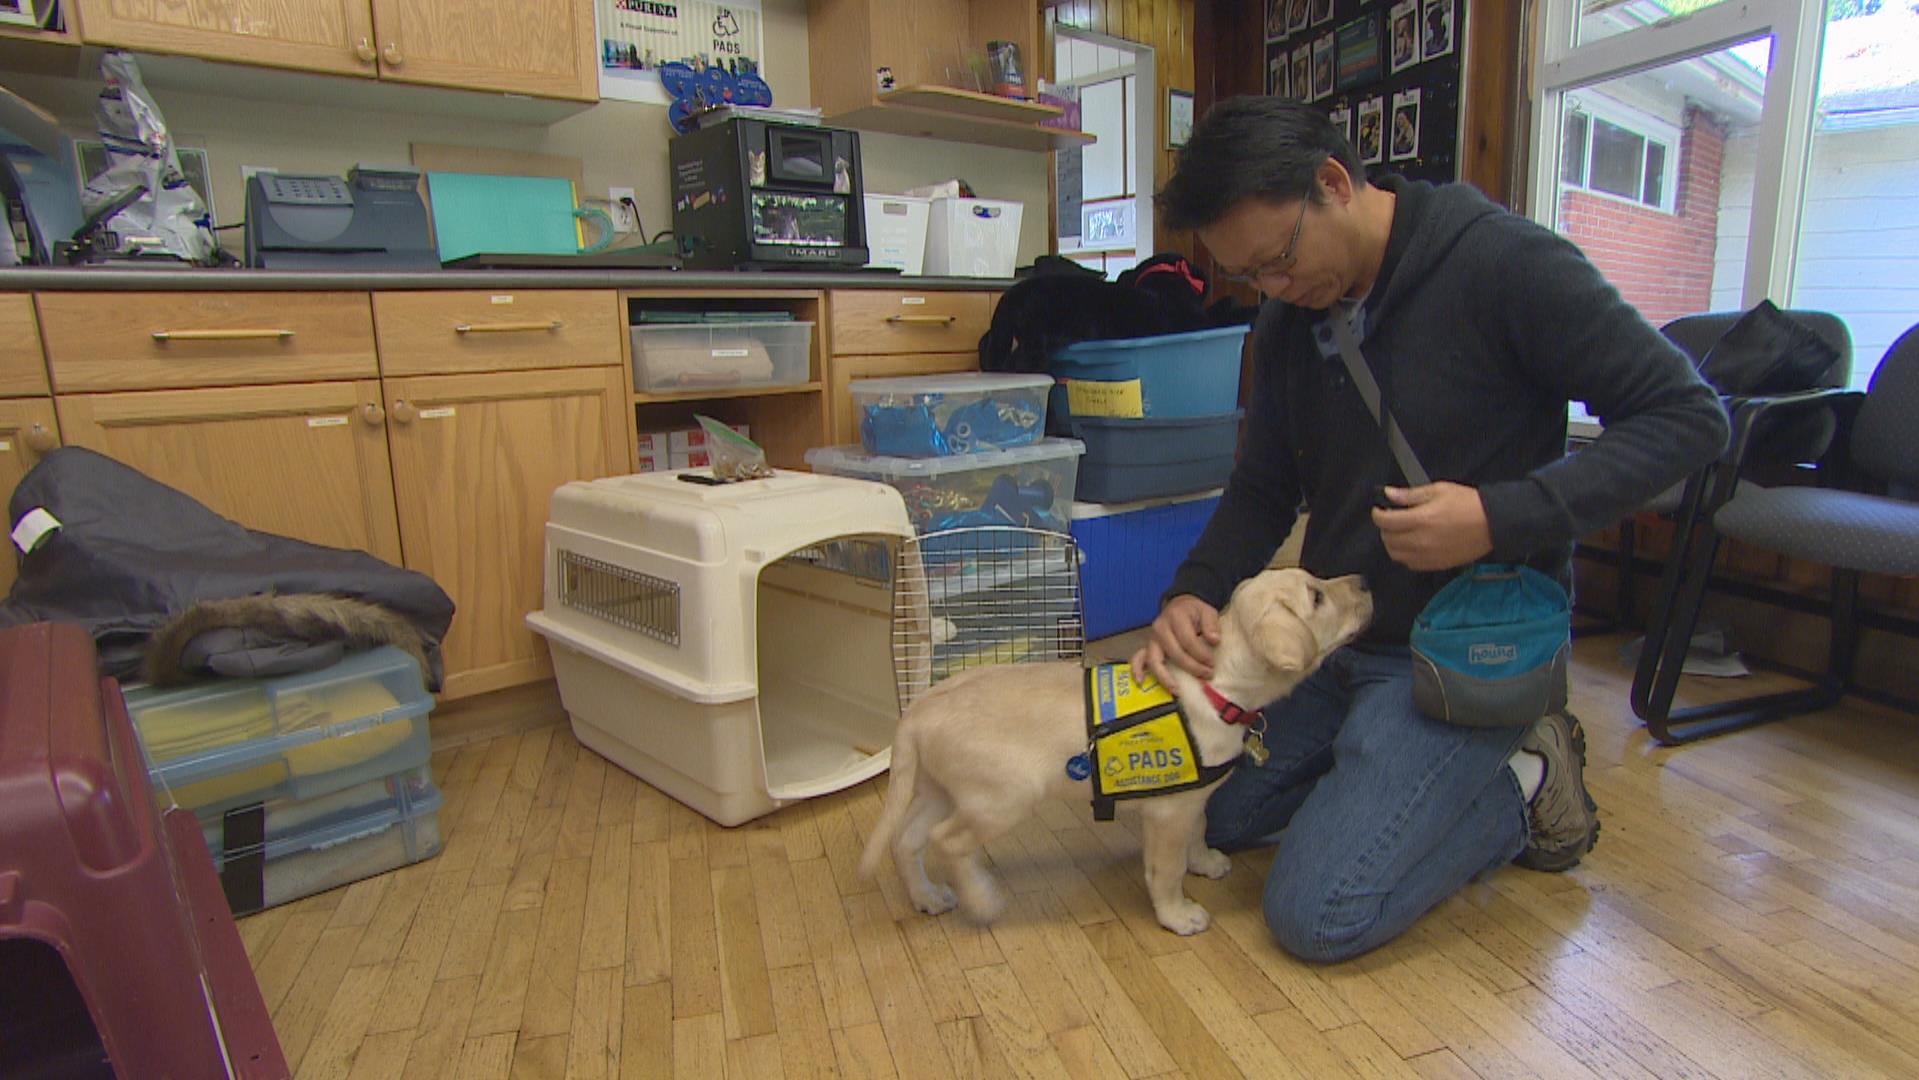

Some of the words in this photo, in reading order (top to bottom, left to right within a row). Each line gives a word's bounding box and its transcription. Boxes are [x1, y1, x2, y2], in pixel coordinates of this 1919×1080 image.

[627, 0, 677, 17] PURINA
[713, 39, 741, 54] PADS
[1471, 646, 1514, 661] hound
[1128, 748, 1183, 771] PADS
